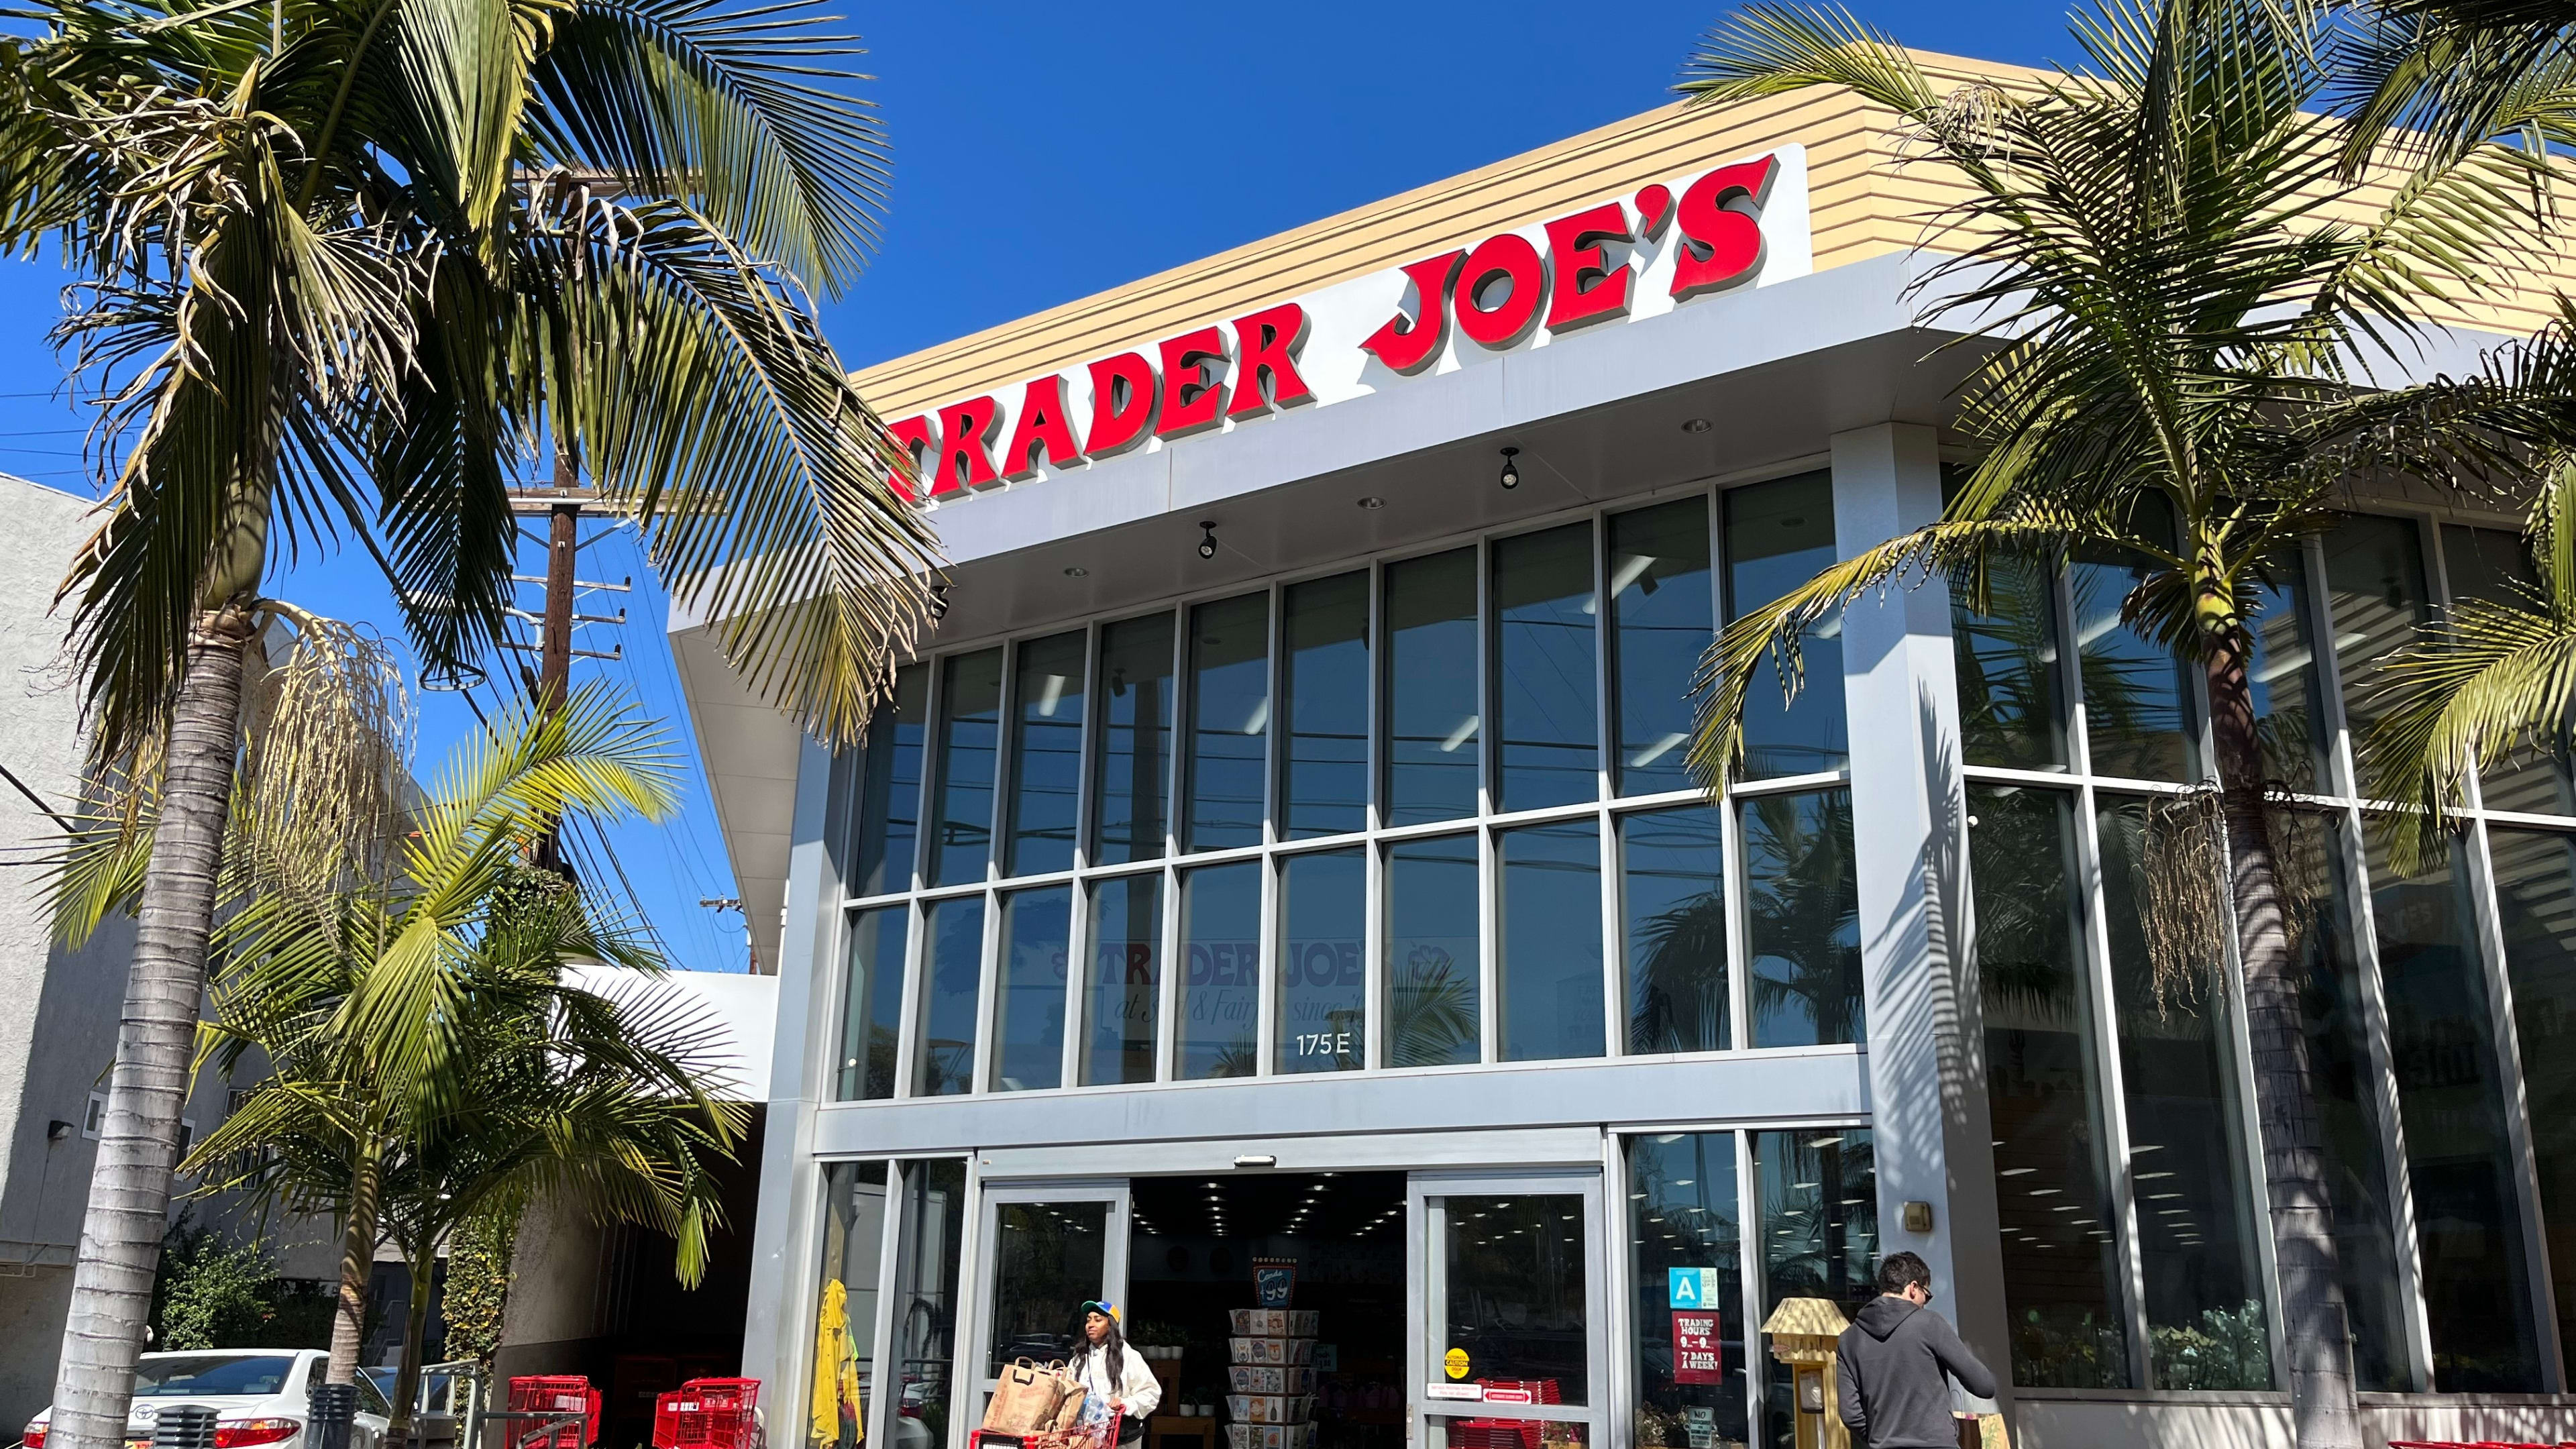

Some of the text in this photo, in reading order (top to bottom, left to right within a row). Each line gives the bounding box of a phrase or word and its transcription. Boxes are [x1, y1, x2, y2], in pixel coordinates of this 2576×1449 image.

[880, 153, 1780, 507] TRADER JOE'S
[1098, 943, 1260, 986] TRDER
[1115, 994, 1140, 1020] at
[1193, 989, 1208, 1020] &
[1676, 1276, 1697, 1300] A
[1678, 1318, 1714, 1328] TRADING
[1680, 1351, 1715, 1361] 7 DAYS
[1681, 1360, 1718, 1370] A WEEK!
[1694, 1410, 1707, 1419] NO
